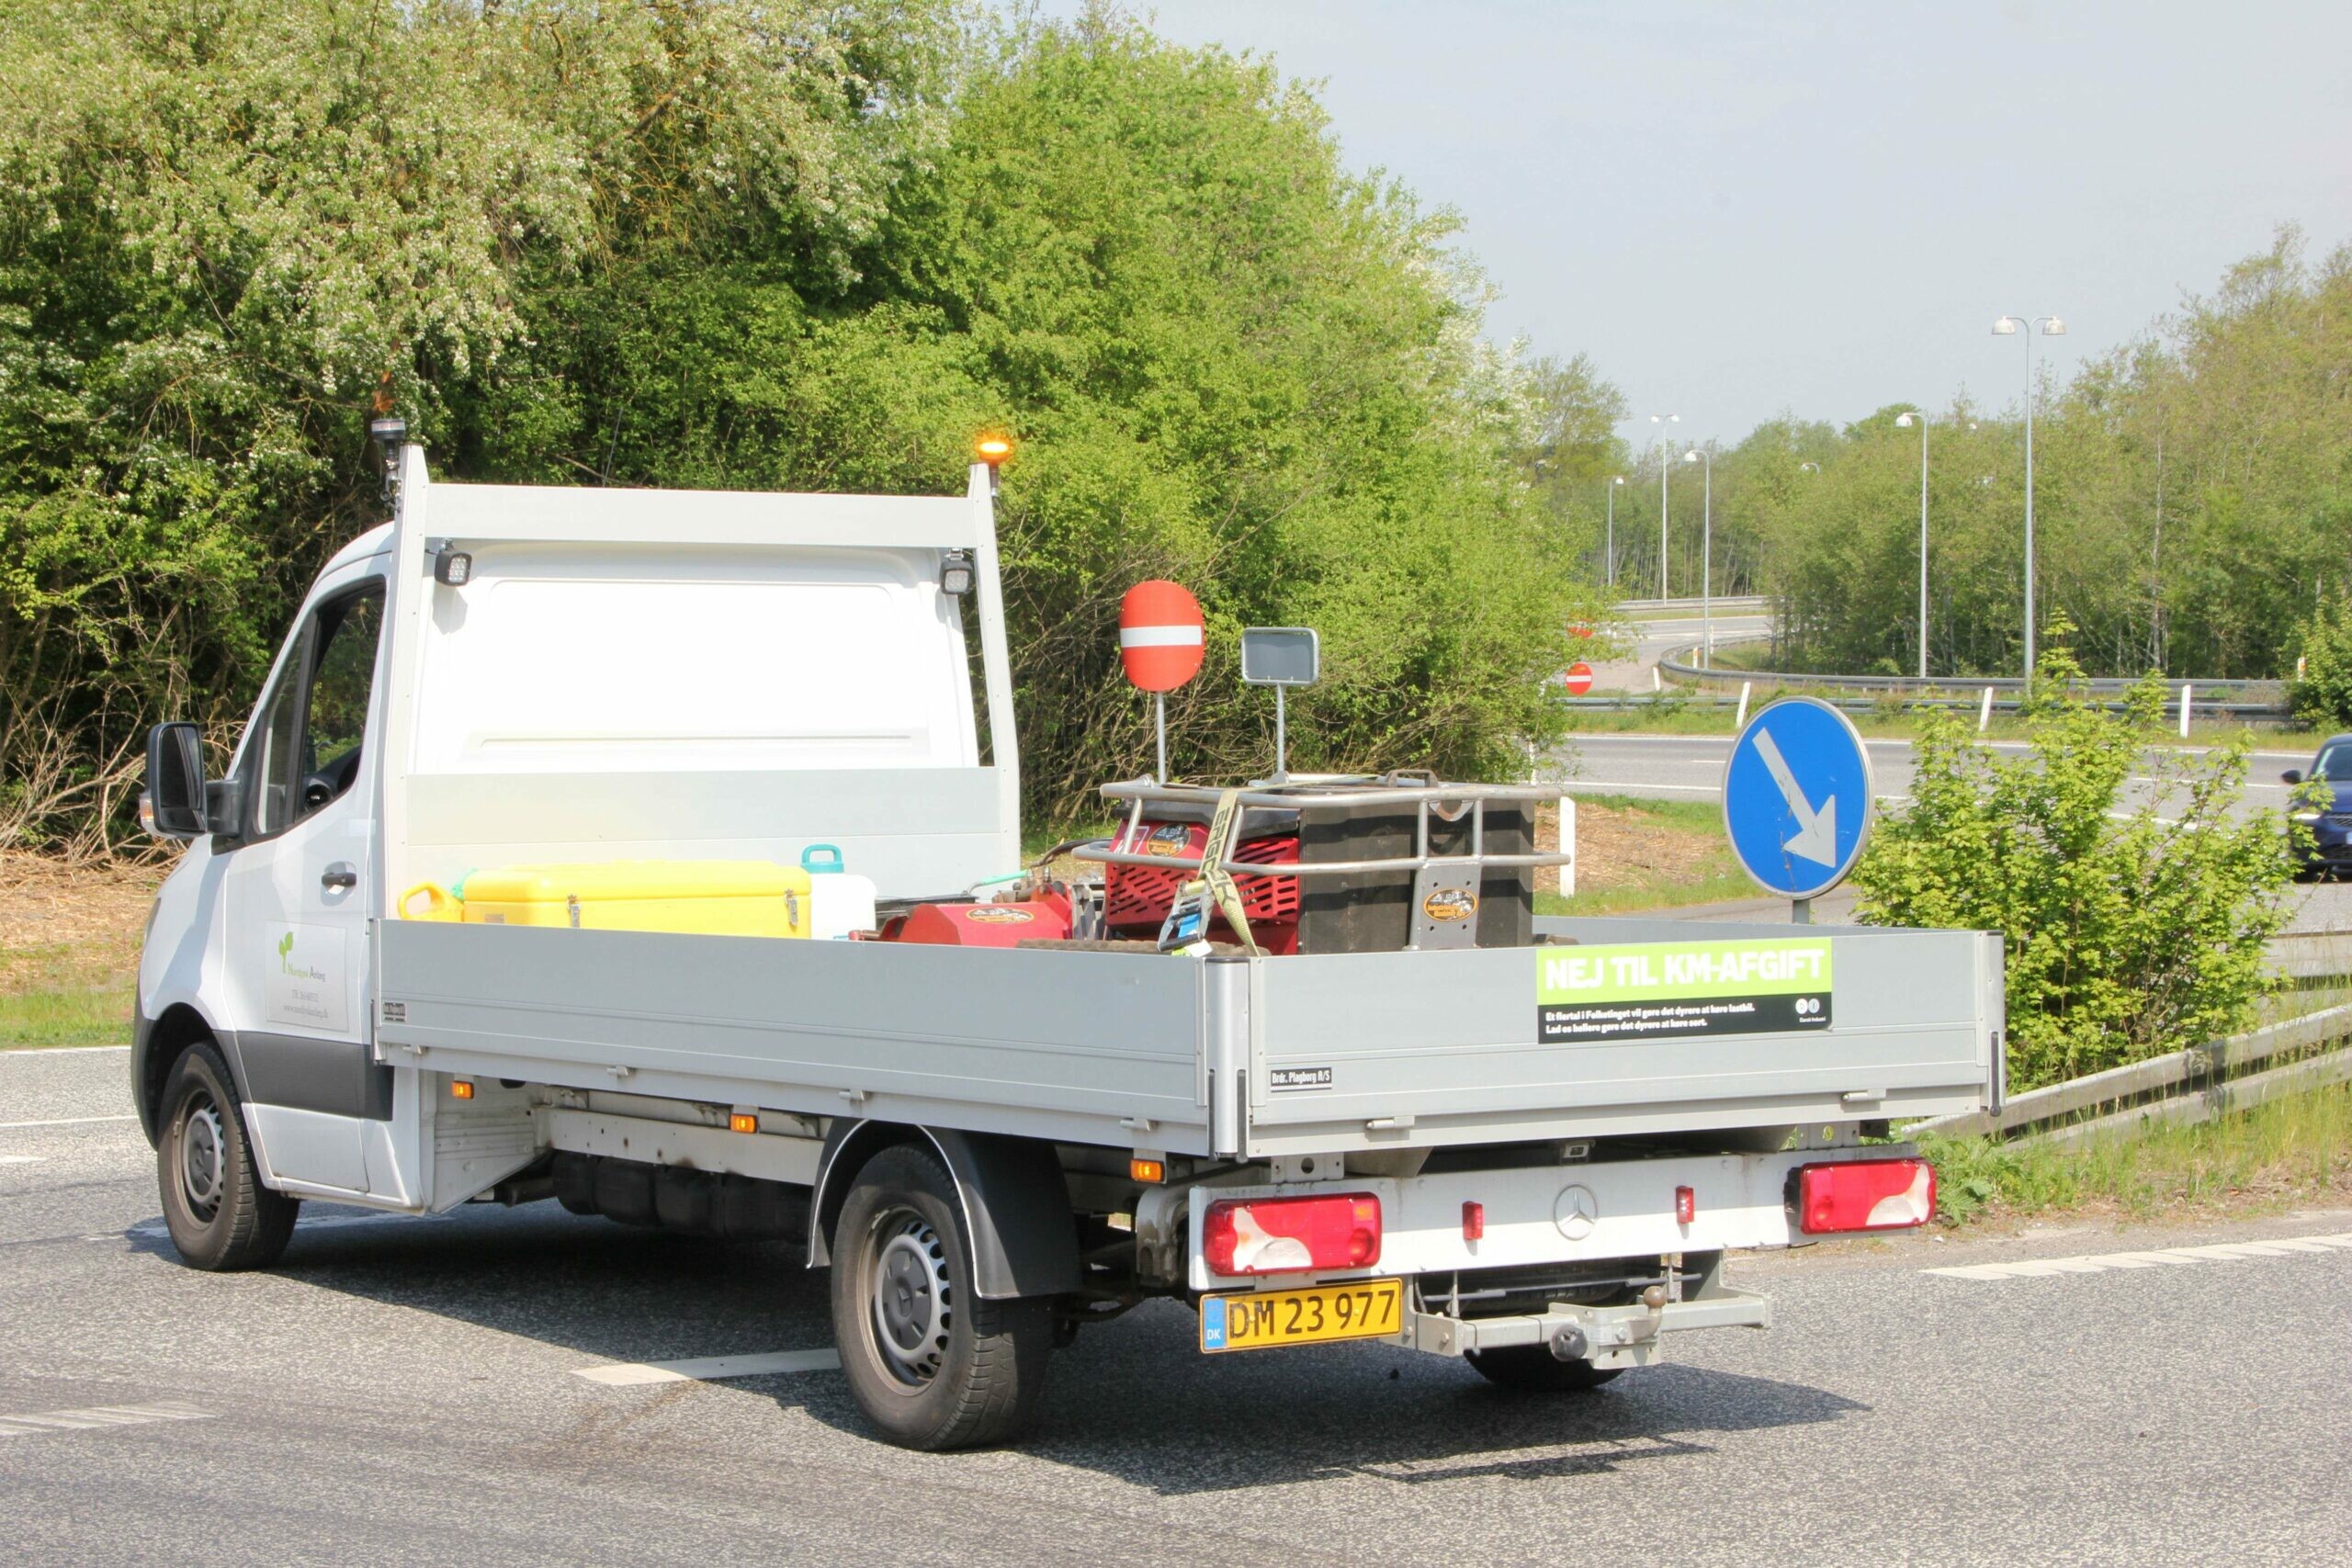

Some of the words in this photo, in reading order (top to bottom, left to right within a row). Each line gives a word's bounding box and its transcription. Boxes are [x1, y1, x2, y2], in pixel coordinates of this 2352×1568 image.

[1545, 958, 1604, 990] NEJ
[1610, 955, 1658, 987] TIL
[1665, 949, 1826, 985] KM-AFGIFT
[1586, 1010, 1631, 1021] Folketinget
[1631, 1008, 1642, 1018] vil
[1661, 1007, 1674, 1017] det
[1675, 1006, 1701, 1017] dyrere
[1701, 1006, 1710, 1014] at
[1545, 1024, 1561, 1033] Lad
[1620, 1021, 1634, 1030] det
[1634, 1021, 1660, 1032] dyrere
[1272, 1072, 1287, 1084] Brdr.
[1317, 1070, 1330, 1081] A/S
[1229, 1300, 1274, 1338] DM
[1285, 1296, 1324, 1335] 23
[1335, 1290, 1396, 1330] 977
[1207, 1328, 1221, 1340] DK
